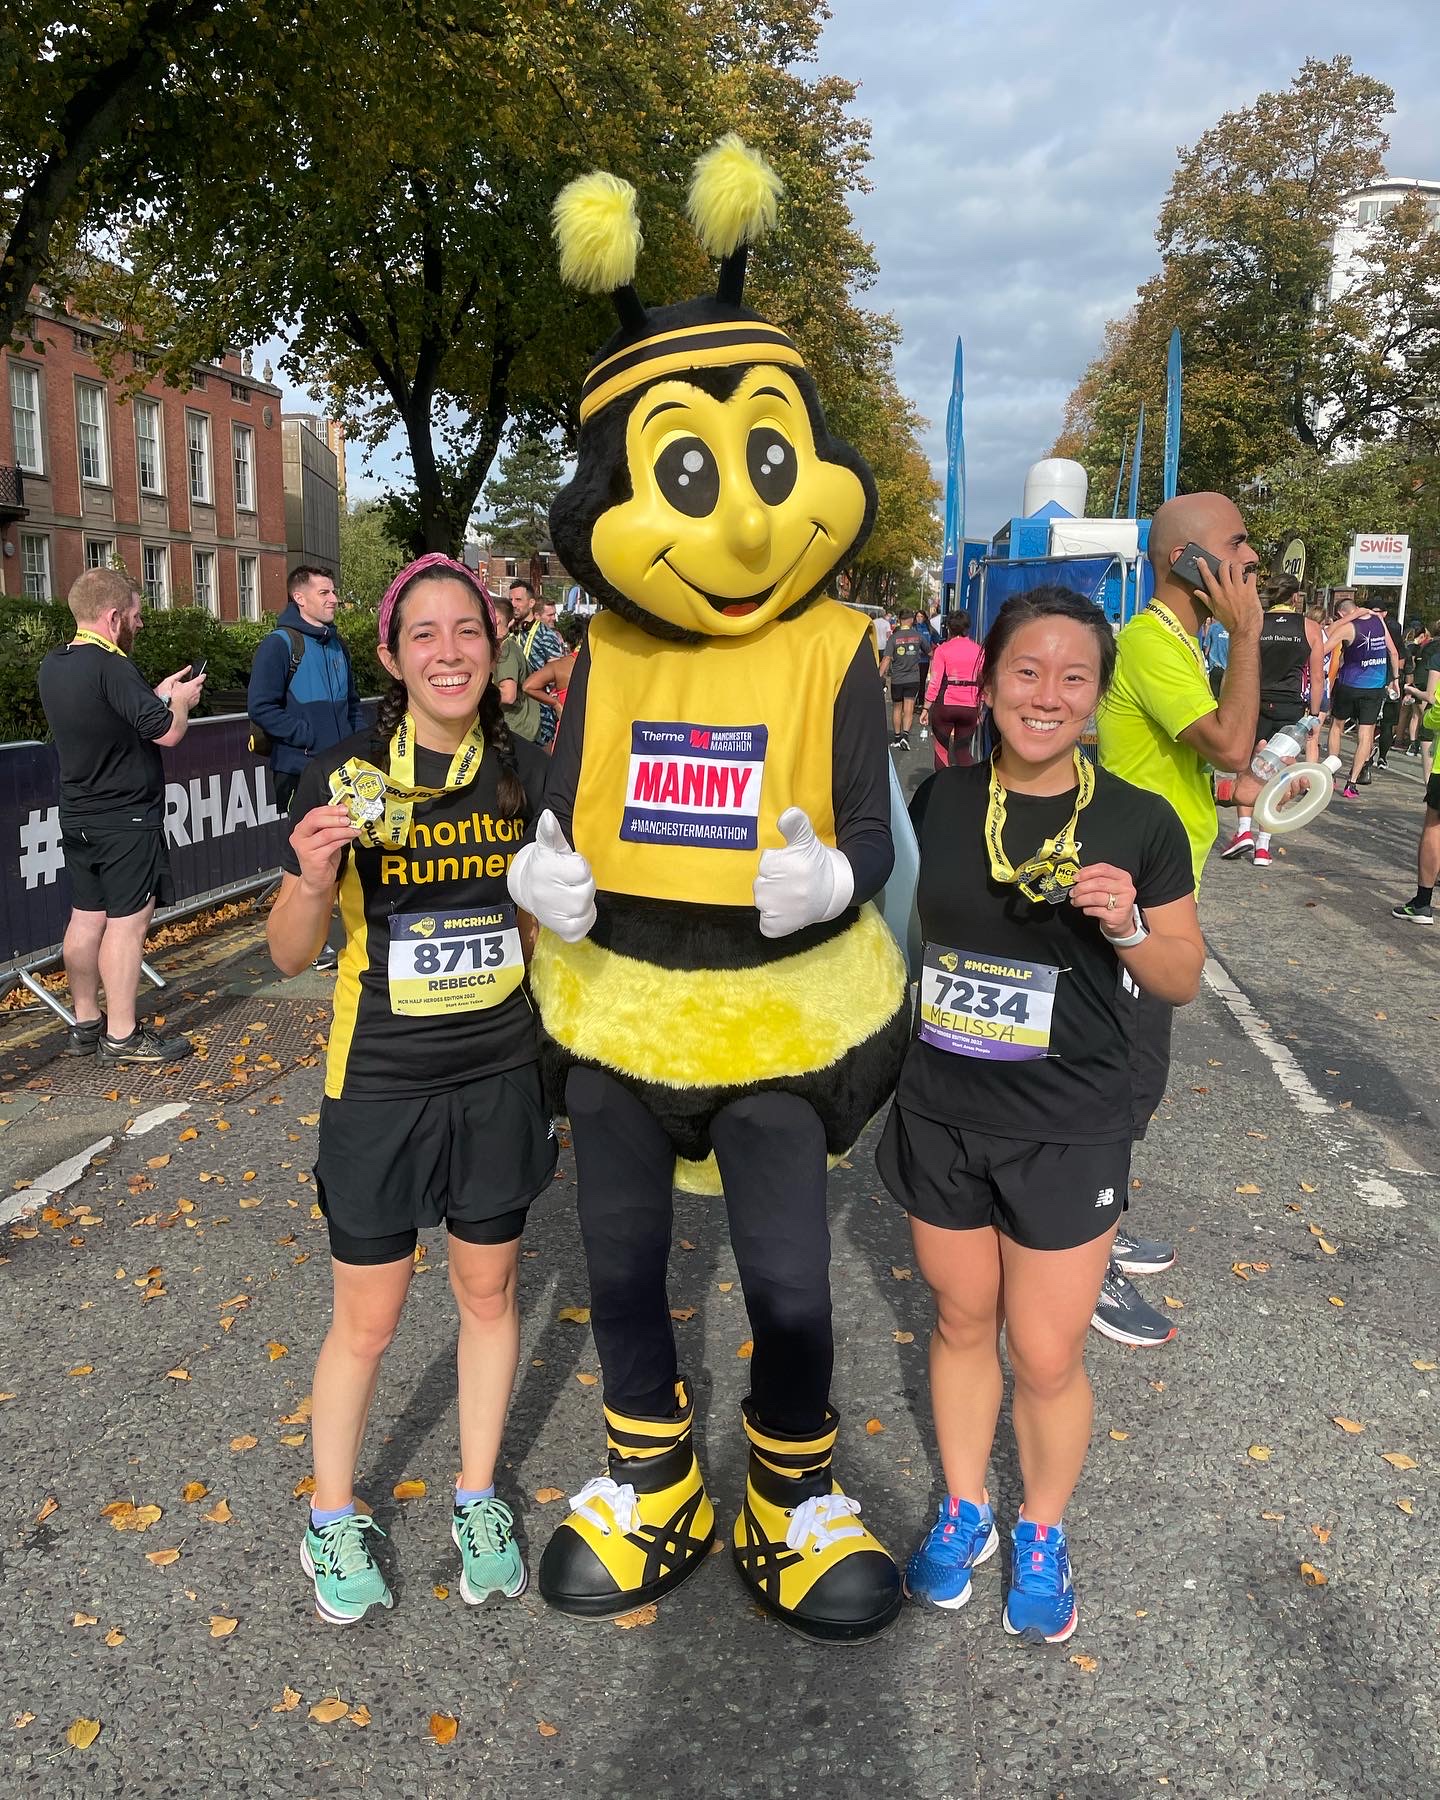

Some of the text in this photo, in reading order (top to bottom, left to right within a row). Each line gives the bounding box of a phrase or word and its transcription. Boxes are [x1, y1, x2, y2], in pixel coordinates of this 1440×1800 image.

[1360, 537, 1403, 553] swiis
[642, 730, 685, 742] Therme
[711, 731, 752, 741] MANCHESTER
[710, 741, 752, 752] MARATHON
[454, 745, 478, 785] FINISHER
[358, 780, 378, 790] MCR
[634, 762, 752, 808] MANNY
[630, 819, 748, 840] #MANCHESTERMARATHON
[443, 913, 504, 930] #MCRHALF
[413, 936, 505, 976] 8713
[963, 958, 1033, 981] #MCRHALF
[428, 973, 496, 992] REBECCA
[934, 974, 1029, 1025] 7234
[930, 1005, 1015, 1043] MELISSA
[952, 1033, 970, 1043] EDITION
[971, 1038, 983, 1046] 2022
